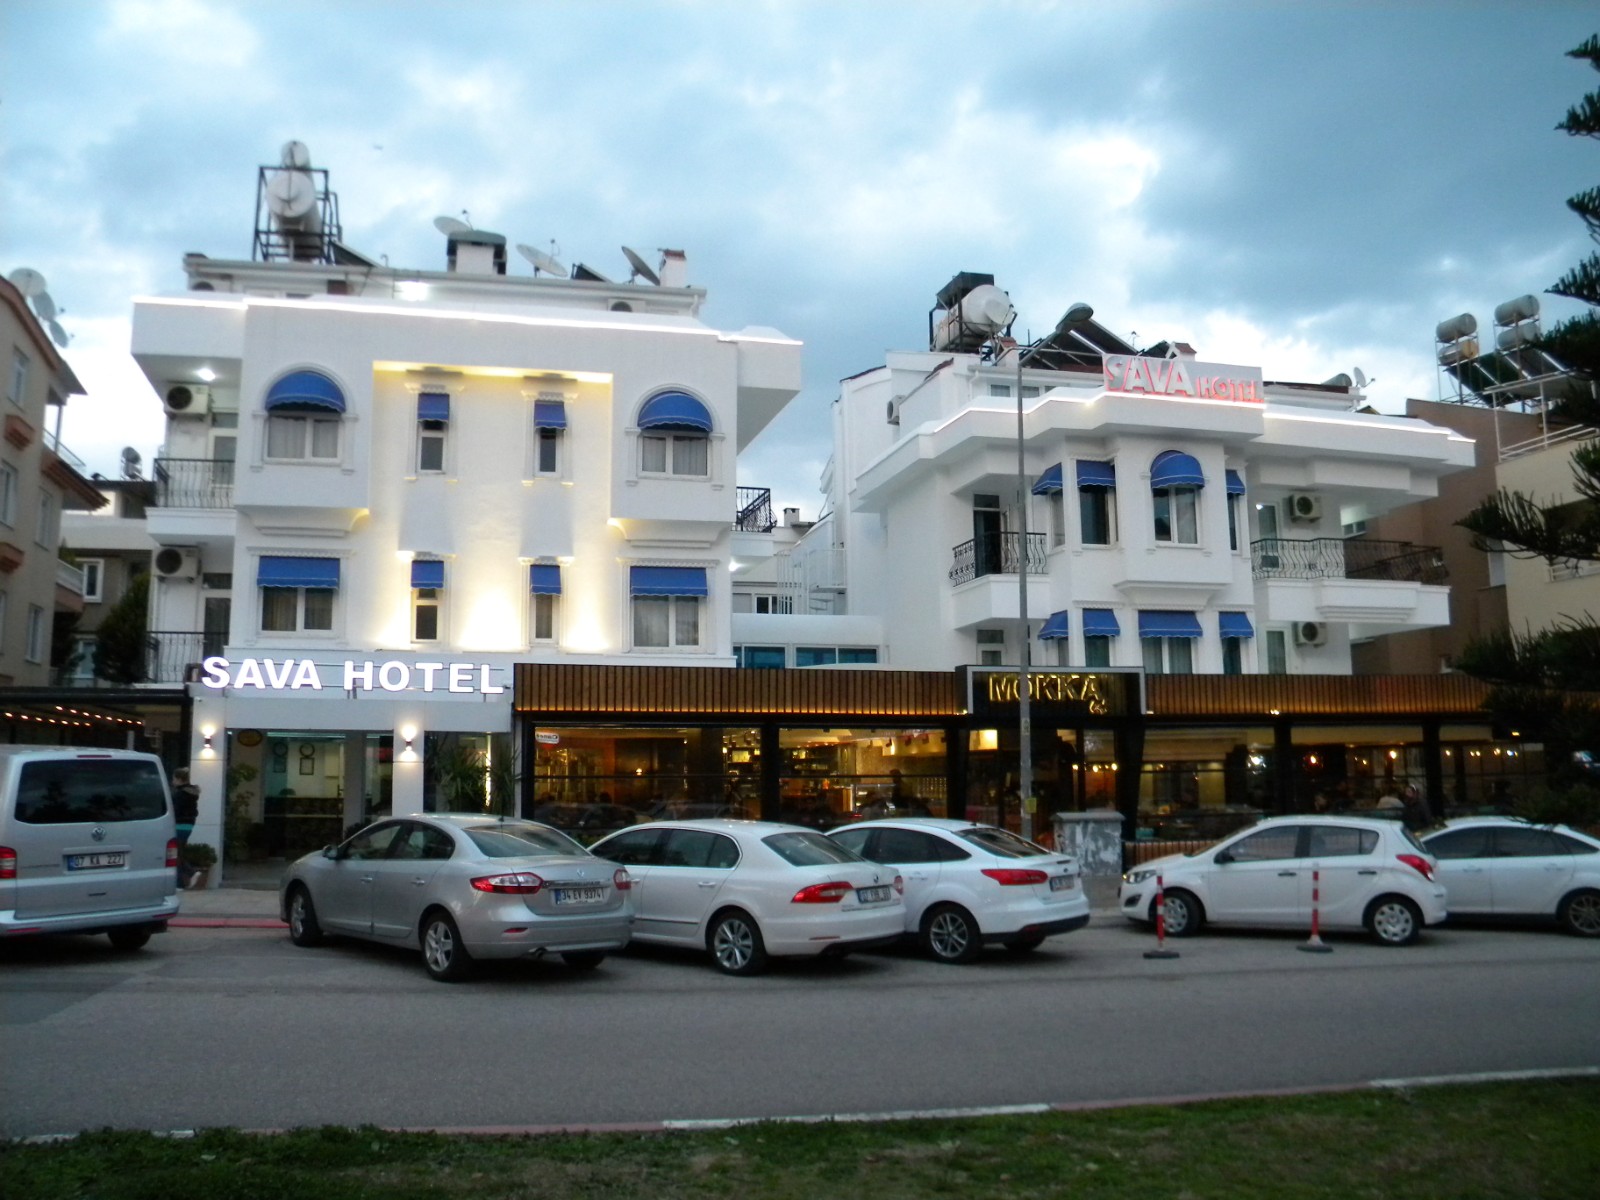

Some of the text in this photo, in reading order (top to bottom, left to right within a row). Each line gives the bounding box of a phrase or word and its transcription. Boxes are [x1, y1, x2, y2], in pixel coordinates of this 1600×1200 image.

[1105, 356, 1265, 403] SAVA HOTEL
[201, 656, 504, 694] SAVA HOTEL
[989, 674, 1099, 701] MOKKA
